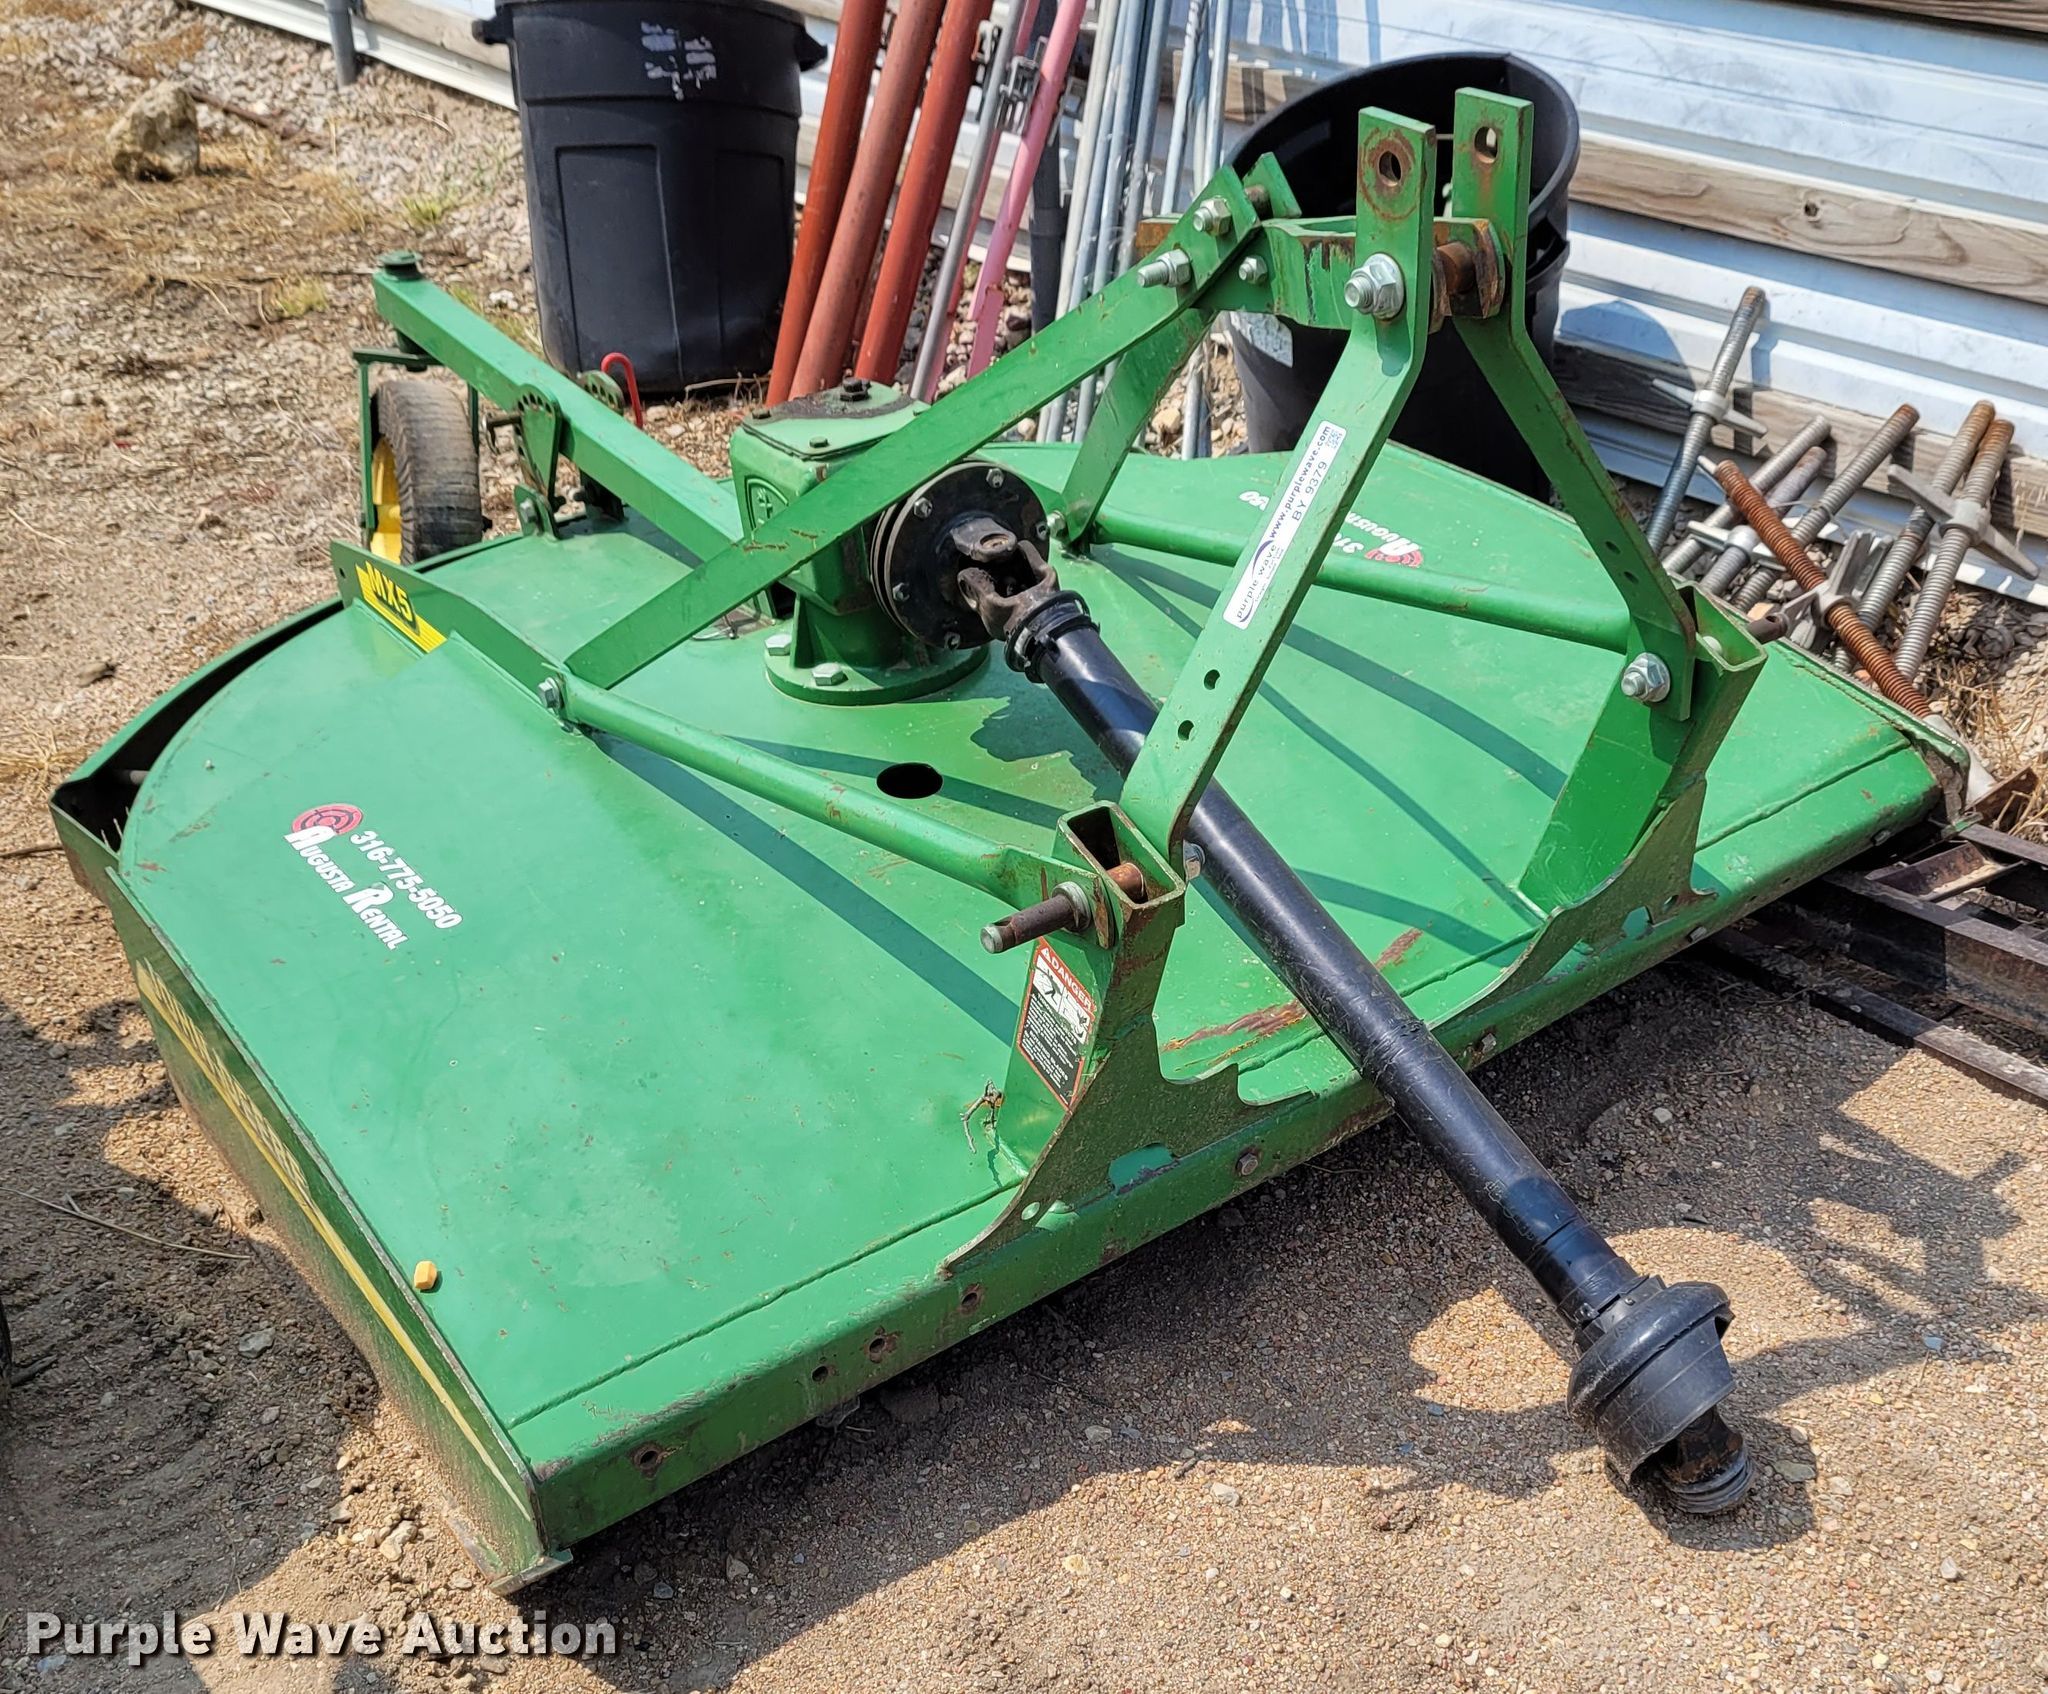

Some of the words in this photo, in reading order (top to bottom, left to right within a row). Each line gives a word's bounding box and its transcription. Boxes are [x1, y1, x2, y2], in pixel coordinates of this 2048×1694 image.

[1269, 425, 1331, 539] www.purplewave.com
[1292, 502, 1307, 521] BY
[1305, 461, 1328, 495] 9379
[365, 560, 414, 623] MX5
[1236, 580, 1259, 619] purple
[1258, 544, 1278, 576] wave
[283, 825, 356, 893] AUGUSTA
[342, 882, 409, 950] RENTAL
[350, 830, 463, 929] 316-775-5050
[1050, 956, 1093, 1011] DANGER
